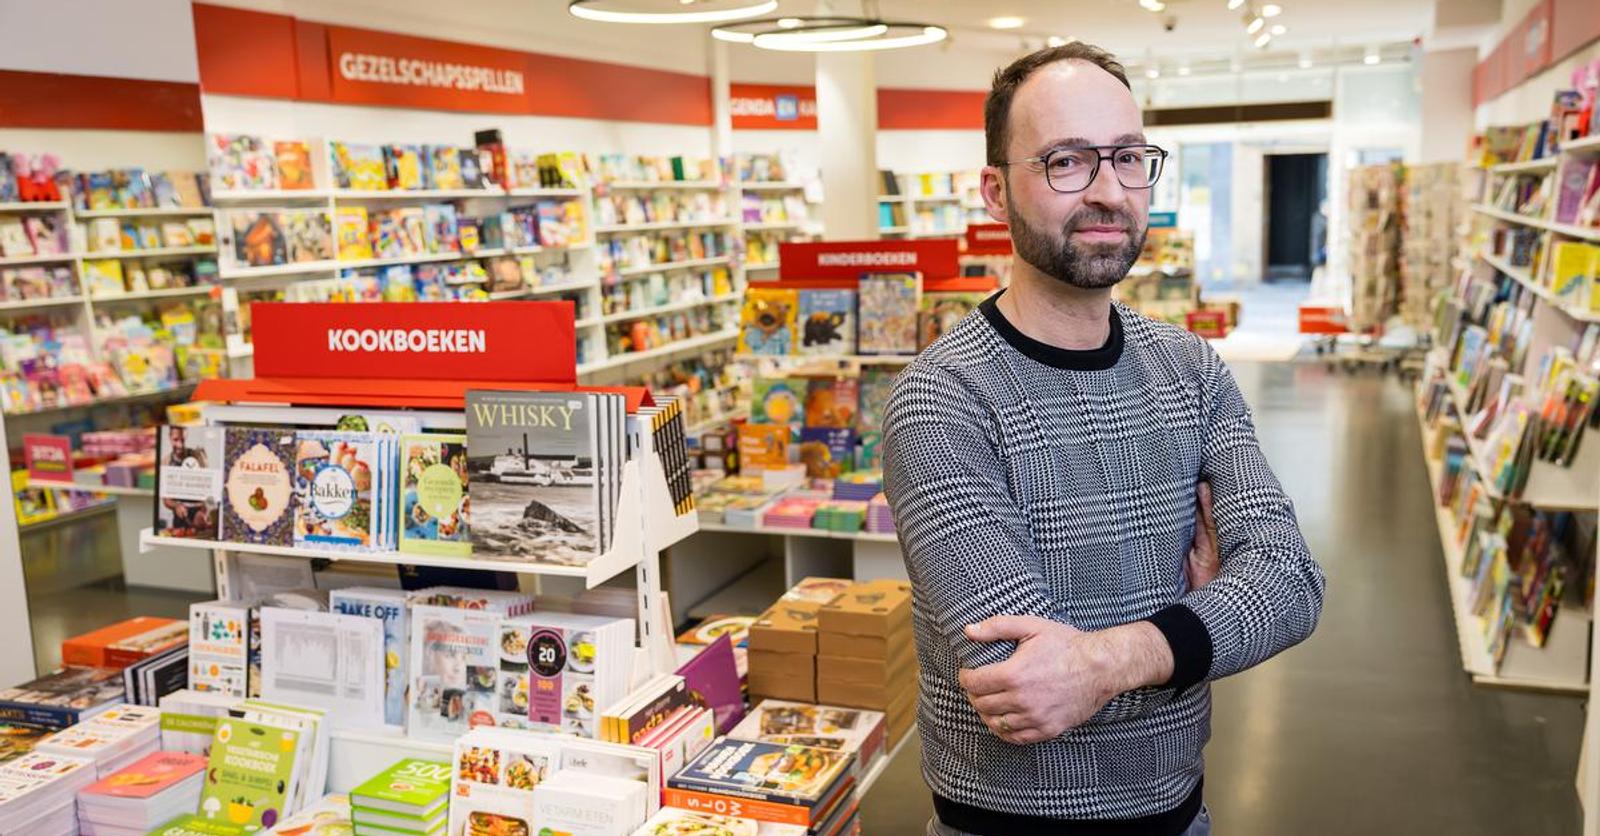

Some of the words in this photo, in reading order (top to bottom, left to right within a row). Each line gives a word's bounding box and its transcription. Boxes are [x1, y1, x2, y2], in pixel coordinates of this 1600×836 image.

[339, 52, 525, 95] GEZELSCHAPSSPELLEN
[817, 252, 917, 265] KINDERBOEKEN
[327, 328, 486, 353] KOOKBOEKEN
[472, 402, 576, 430] WHISKY
[240, 461, 280, 473] FALAFEL
[309, 480, 359, 498] Bakken
[340, 602, 371, 617] BAKE
[374, 605, 399, 622] OFF
[538, 647, 556, 663] 20
[396, 762, 452, 780] 500
[540, 804, 582, 818] VETARM
[585, 809, 614, 823] ETEN
[687, 798, 742, 816] SLOW
